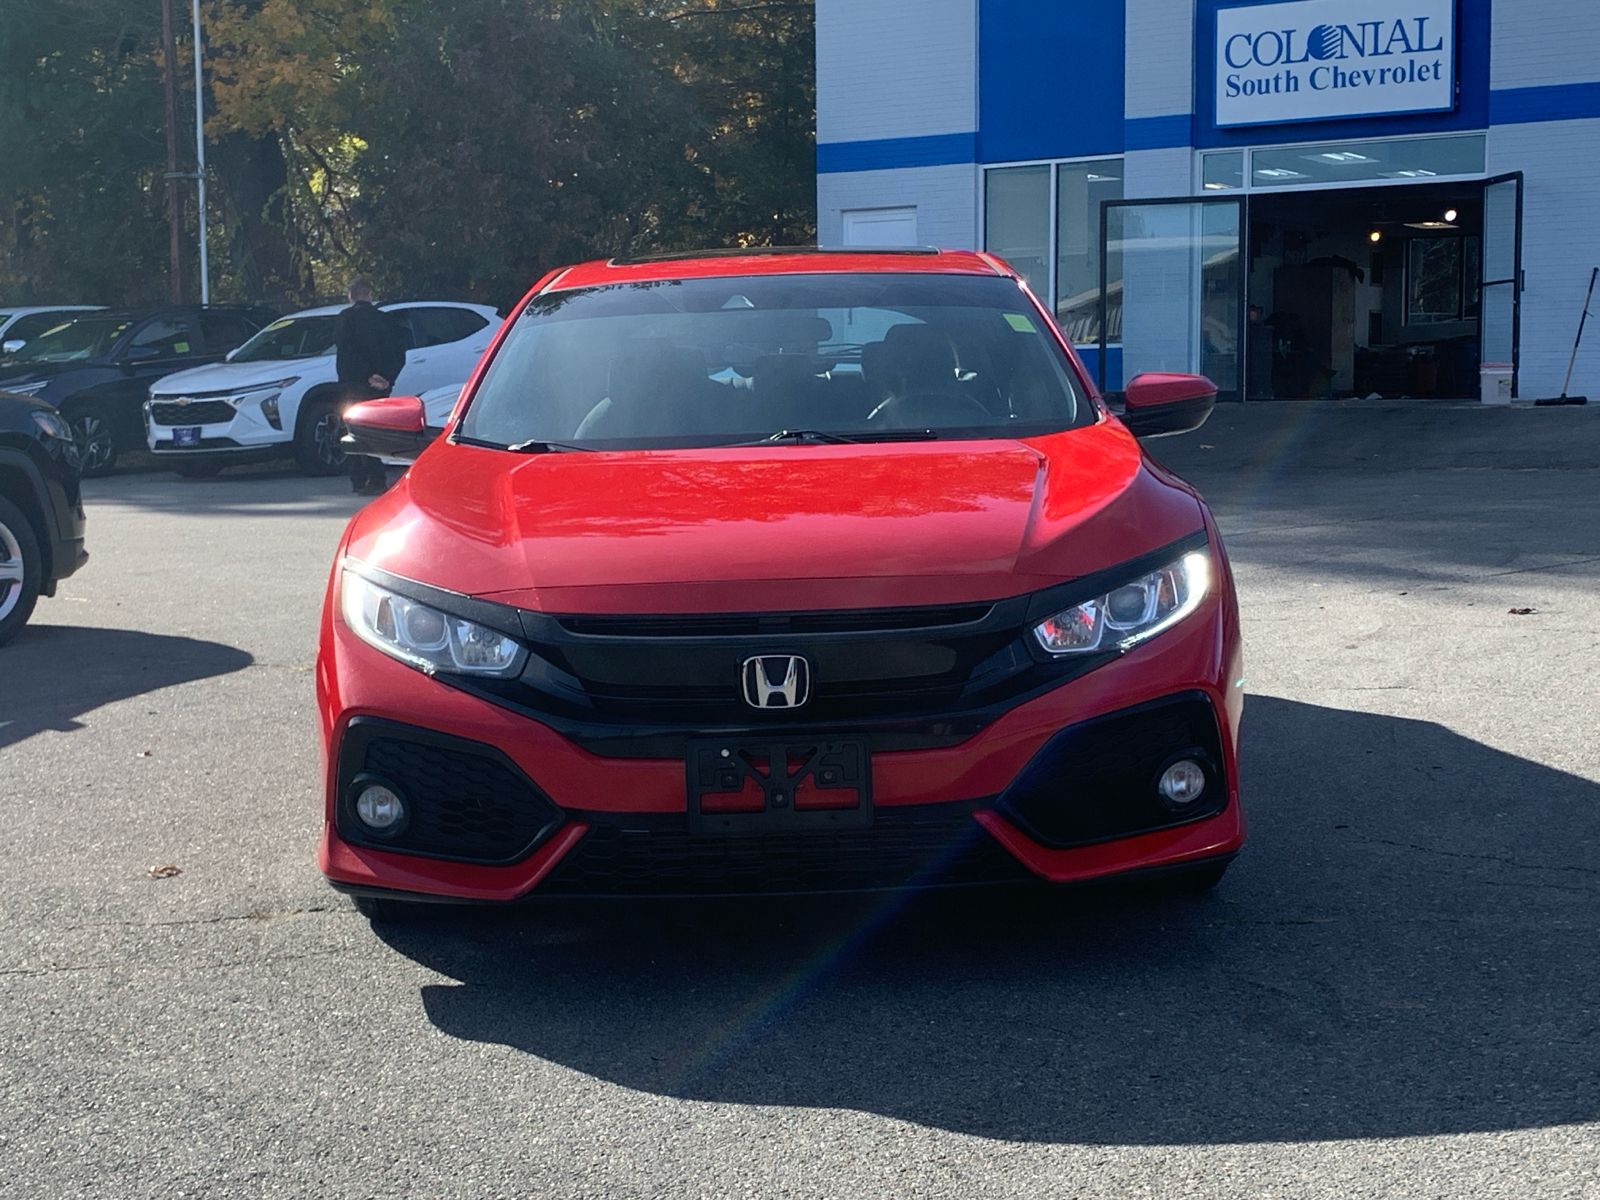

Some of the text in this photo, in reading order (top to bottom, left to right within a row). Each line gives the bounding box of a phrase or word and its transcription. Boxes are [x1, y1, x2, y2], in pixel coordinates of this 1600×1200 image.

[1224, 17, 1443, 69] COLONIAL
[1225, 58, 1443, 98] South Chevrolet
